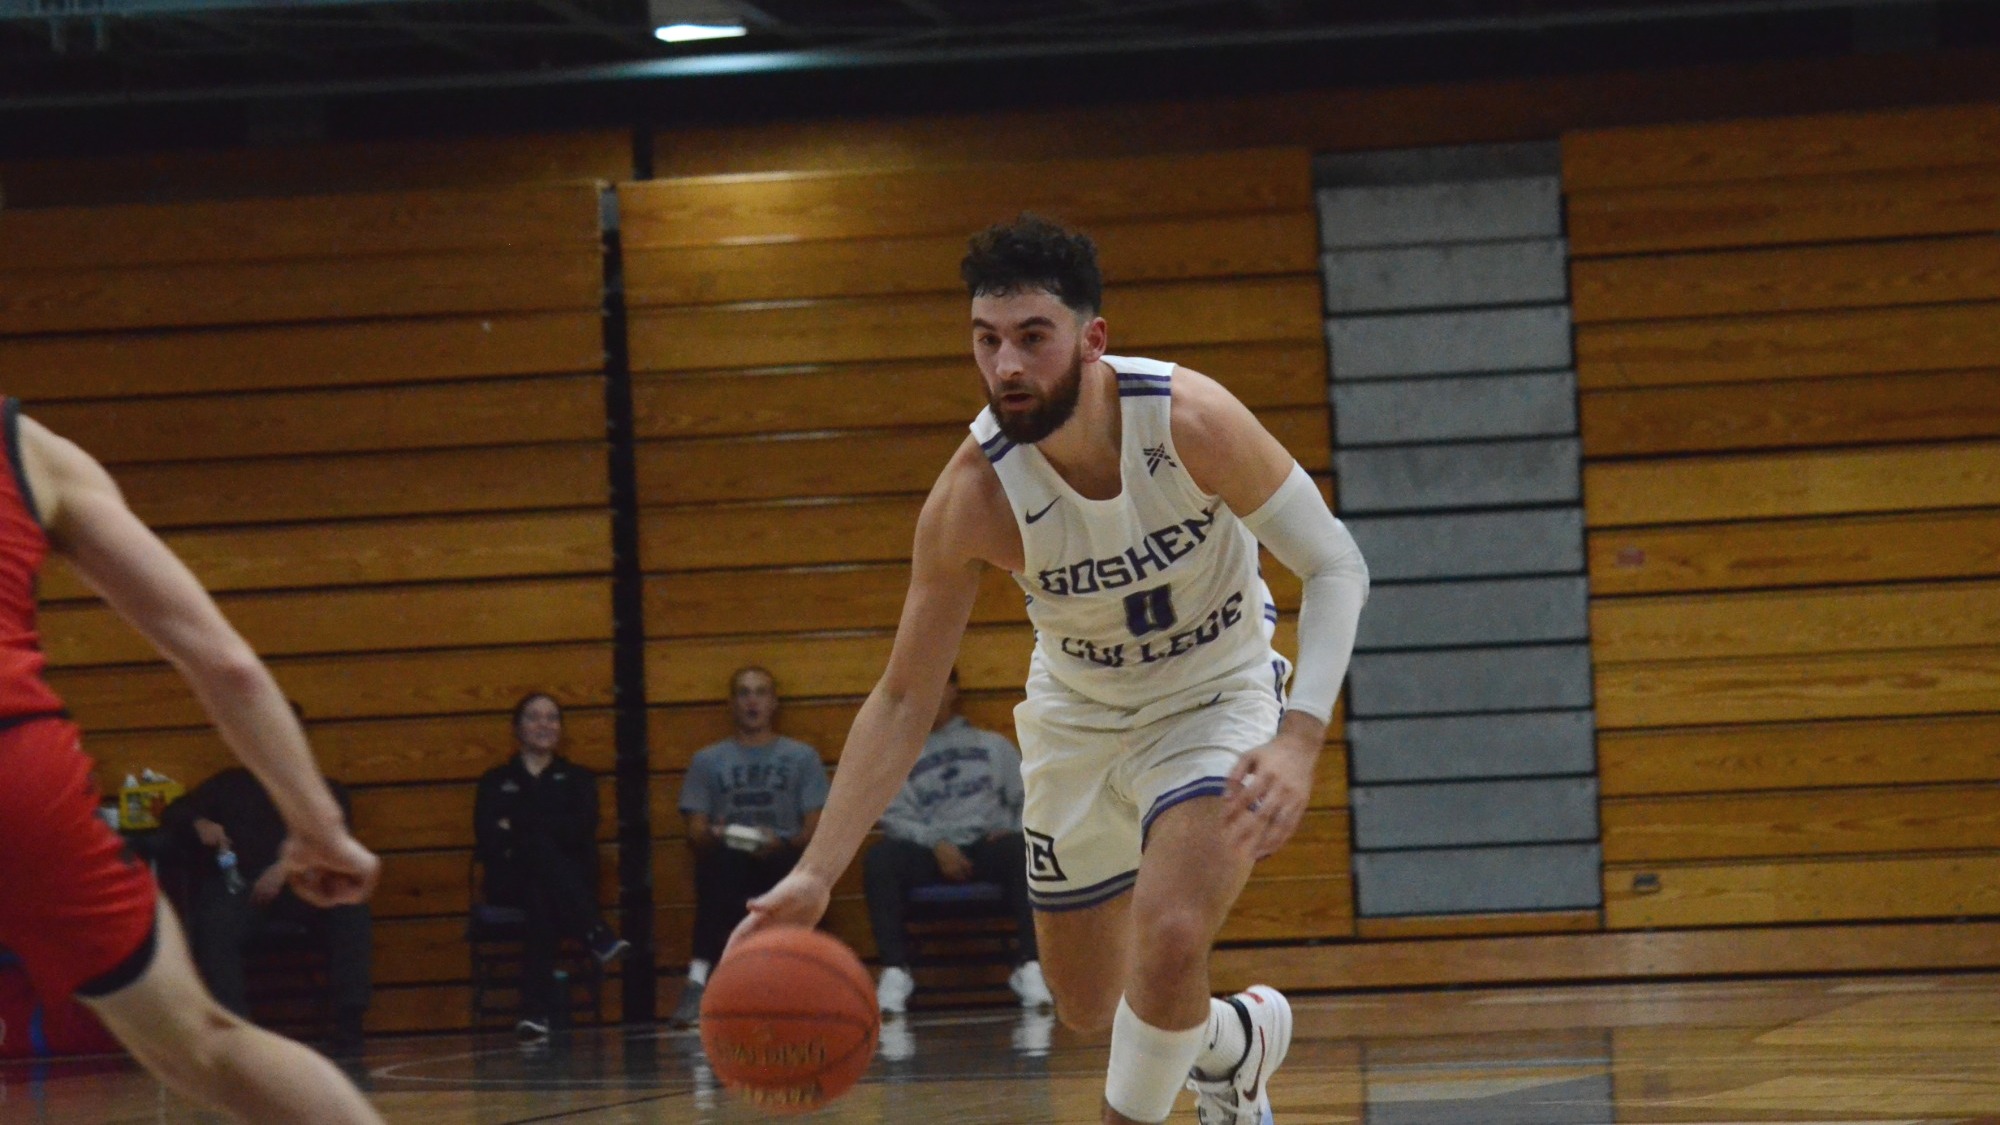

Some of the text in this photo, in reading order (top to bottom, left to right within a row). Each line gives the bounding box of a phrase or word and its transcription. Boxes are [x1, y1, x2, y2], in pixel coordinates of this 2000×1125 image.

[1038, 507, 1215, 596] GOSHEN
[1061, 591, 1243, 667] COLLEGE
[1123, 582, 1178, 637] 0
